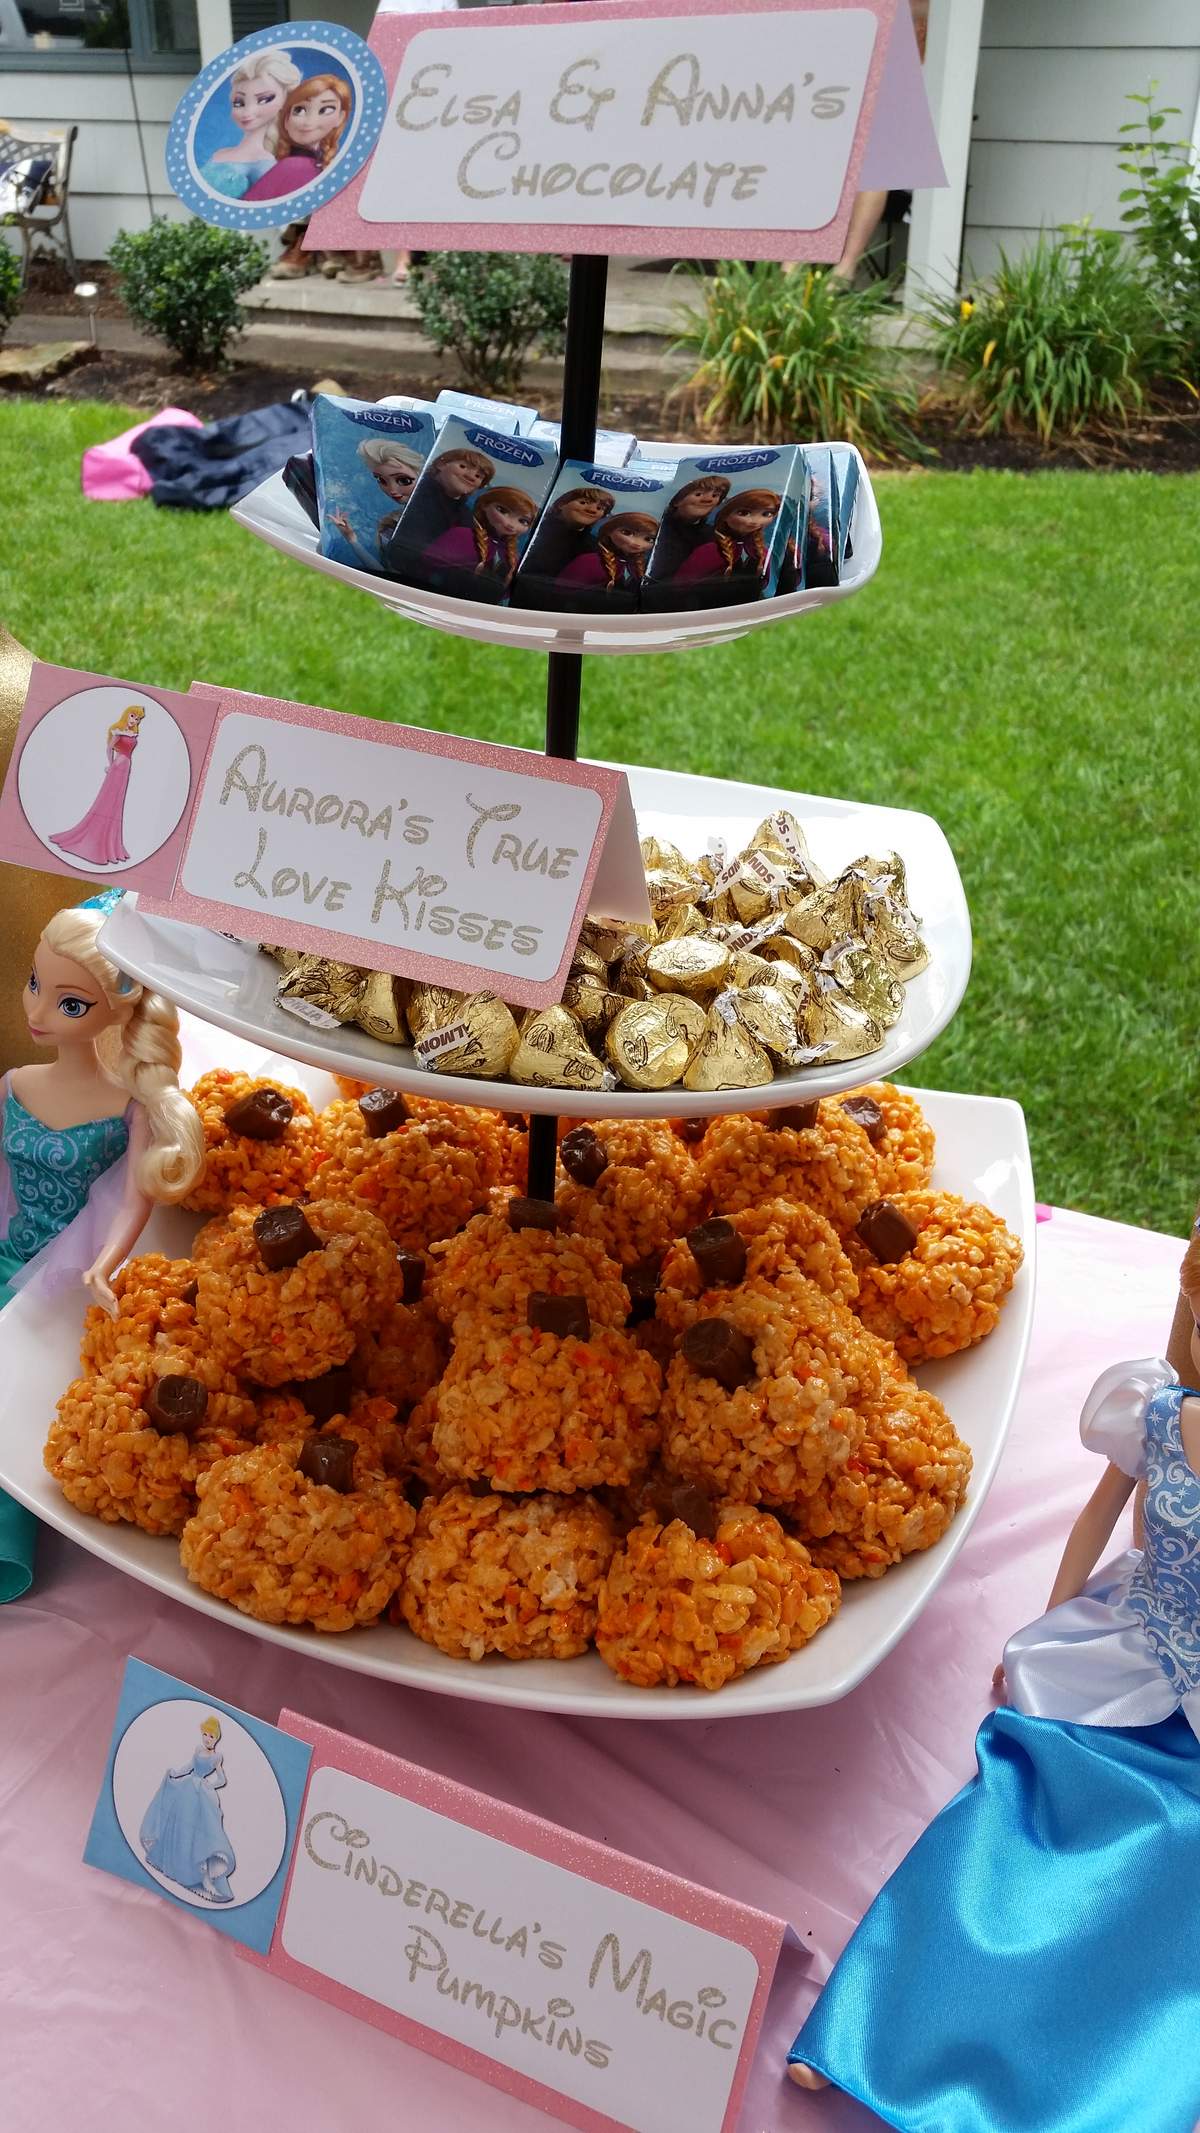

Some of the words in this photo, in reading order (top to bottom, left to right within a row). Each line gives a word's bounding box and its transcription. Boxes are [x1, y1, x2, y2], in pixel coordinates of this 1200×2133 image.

[548, 57, 615, 131] &
[354, 410, 412, 428] FROZEN
[473, 432, 534, 463] FROZEN
[707, 453, 769, 469] FROZEN
[591, 471, 652, 489] FROZEN
